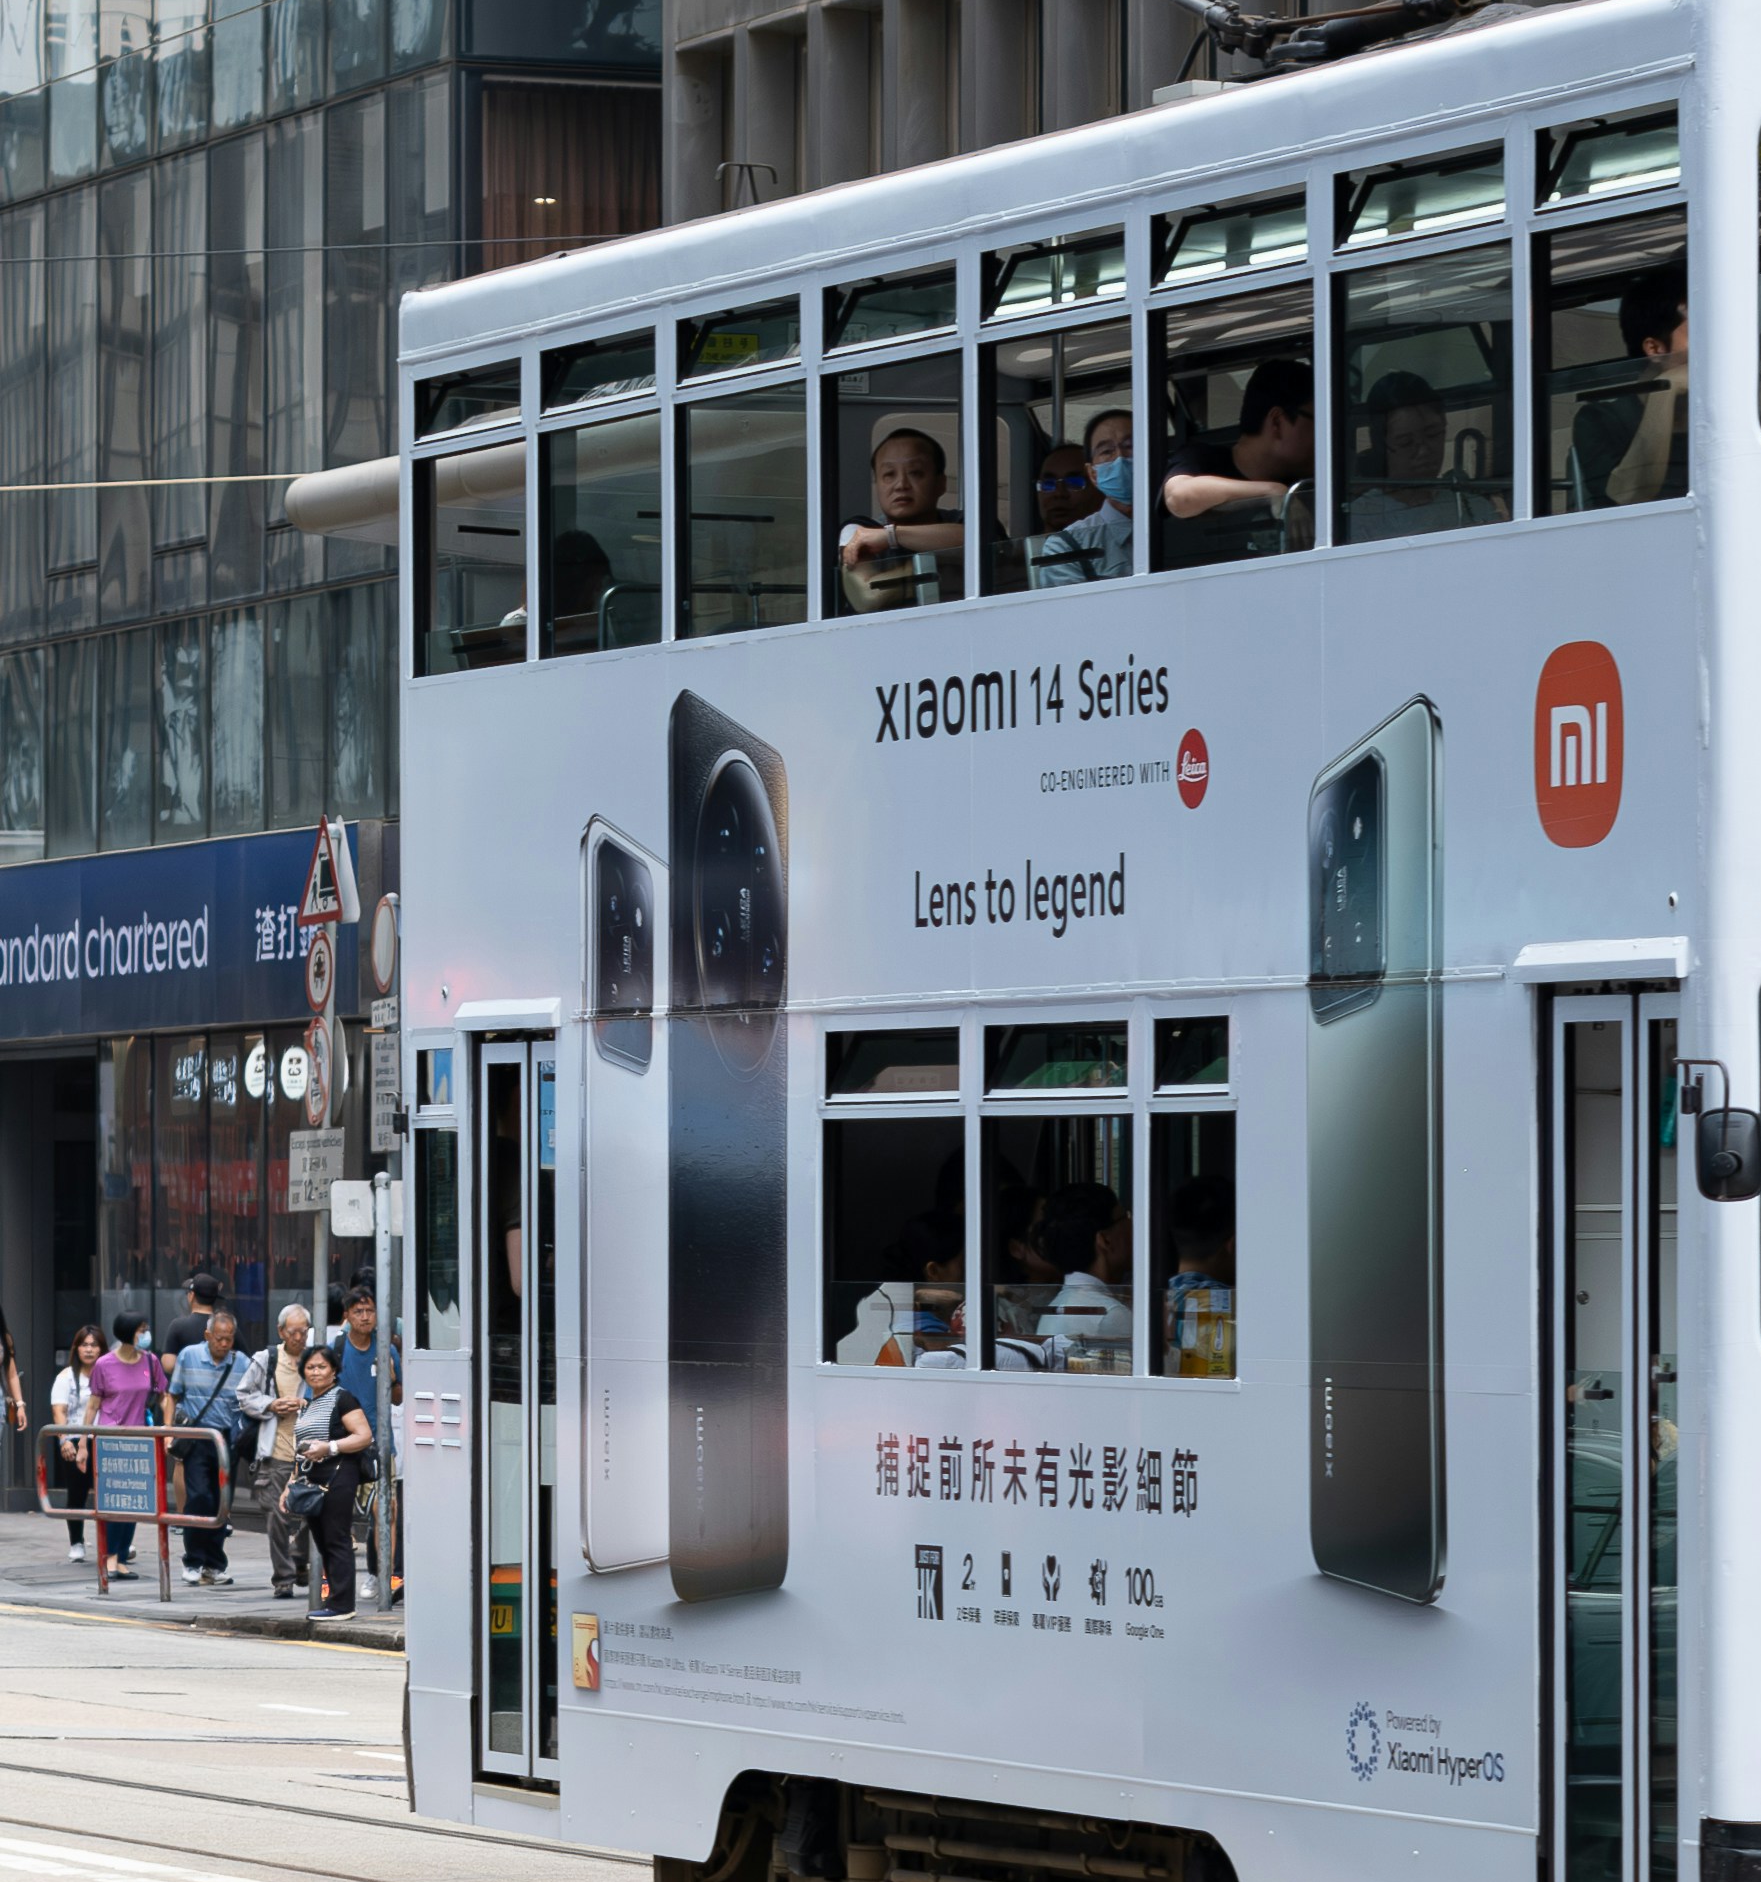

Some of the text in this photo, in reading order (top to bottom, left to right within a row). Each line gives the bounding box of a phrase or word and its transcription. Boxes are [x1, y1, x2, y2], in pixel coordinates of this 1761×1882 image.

[1030, 663, 1065, 726] 14
[1078, 653, 1169, 721] Series
[1040, 750, 1208, 793] CO-ENGINEERED WITH Leica
[914, 851, 1125, 939] Lens to legend
[84, 904, 209, 978] chartered
[876, 1432, 1199, 1519] 捕捉前所未有光影細節
[917, 1567, 938, 1620] HK
[1385, 1709, 1442, 1739] Powered by
[1387, 1741, 1505, 1787] Xiaomi HyperOS
